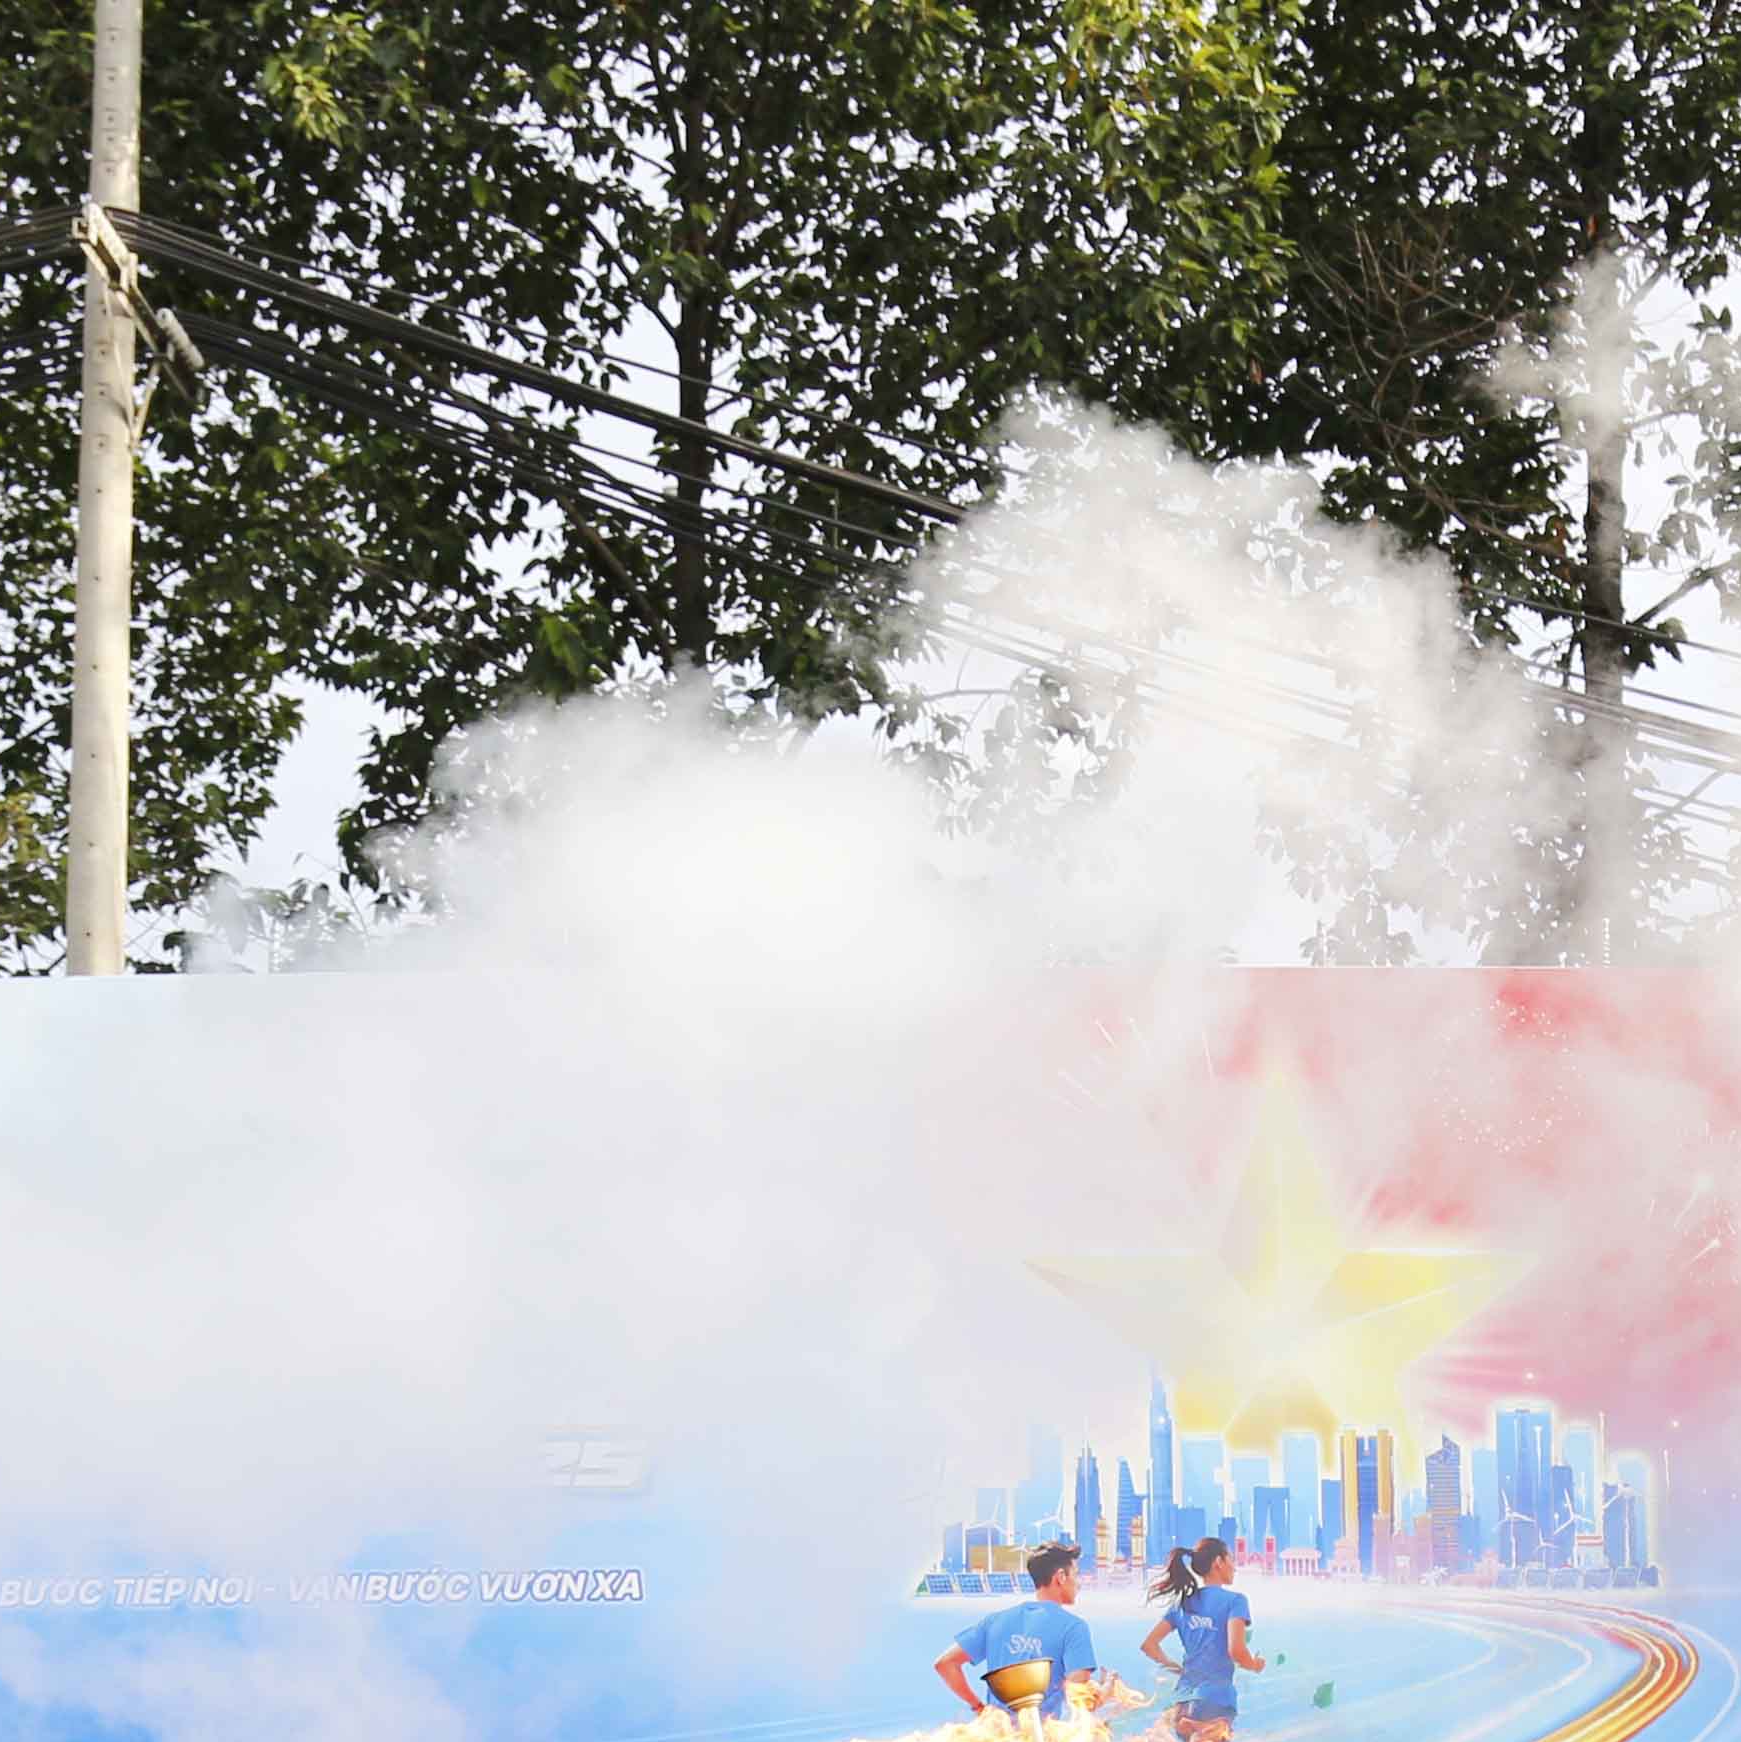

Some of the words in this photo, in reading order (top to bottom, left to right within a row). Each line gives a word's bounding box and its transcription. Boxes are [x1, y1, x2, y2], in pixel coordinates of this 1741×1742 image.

[362, 1561, 472, 1603] BƯỚC
[479, 1566, 587, 1603] VƯƠN
[589, 1568, 645, 1603] XA
